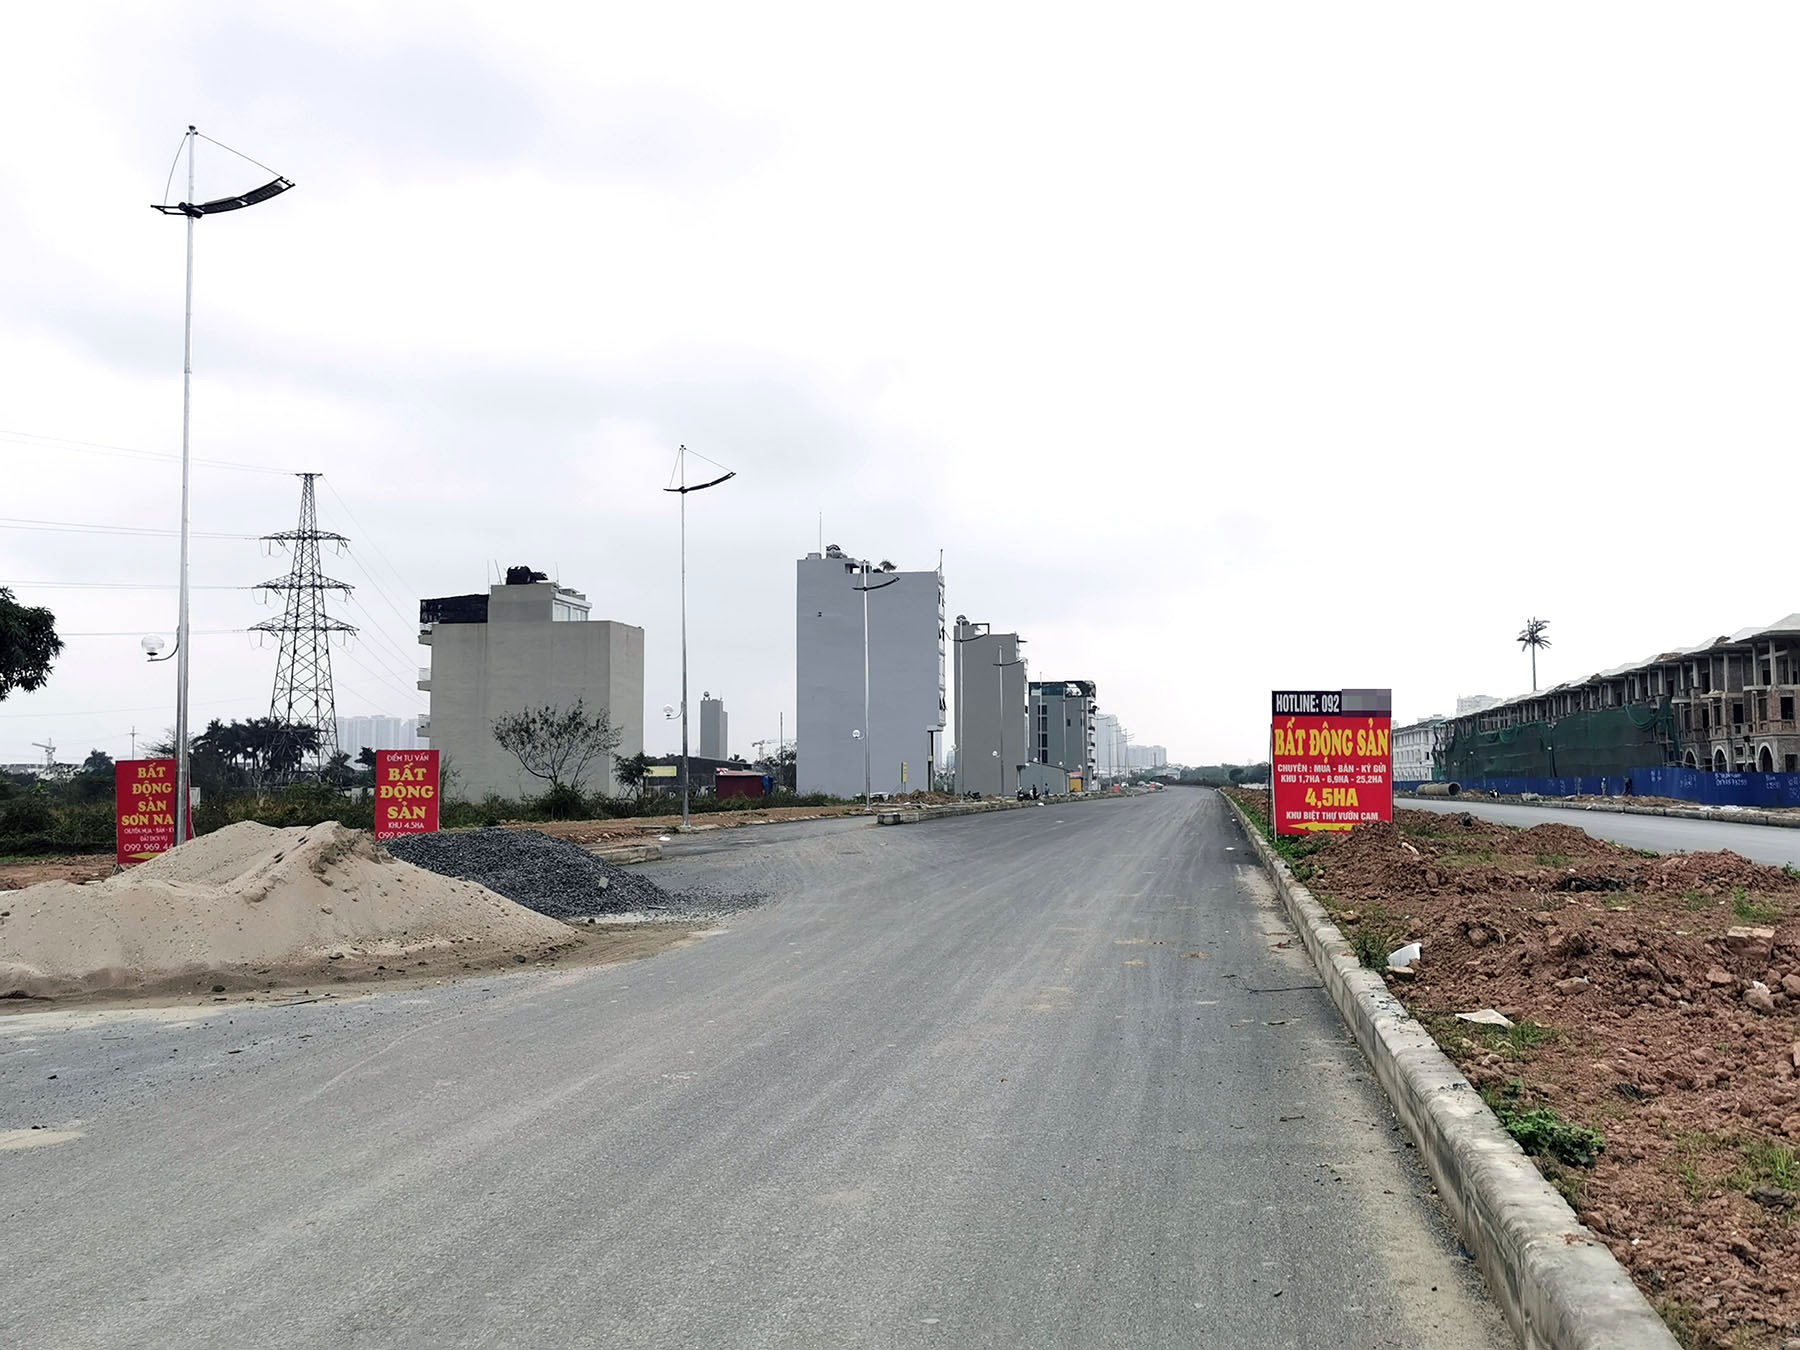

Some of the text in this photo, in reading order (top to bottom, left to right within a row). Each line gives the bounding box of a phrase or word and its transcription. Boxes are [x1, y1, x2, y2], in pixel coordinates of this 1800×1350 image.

[1276, 694, 1319, 712] HOTLINE:
[1274, 716, 1389, 764] BẤT ĐỘNG SẢN
[137, 762, 166, 778] BẤT
[388, 763, 427, 781] BẤT
[1277, 763, 1308, 773] CHUYÊN
[1313, 764, 1331, 773] MUA
[1280, 775, 1297, 784] KHU
[132, 780, 172, 797] ĐỘNG
[380, 782, 434, 802] ĐỘNG
[138, 797, 167, 812] SẢN
[1305, 788, 1359, 809] 4,5HA
[387, 801, 426, 819] SẢN
[1286, 811, 1302, 820] KHU
[1303, 810, 1320, 822] BIỆT
[1361, 812, 1379, 820] CAM
[121, 813, 149, 826] SƠN
[388, 821, 402, 829] KHU
